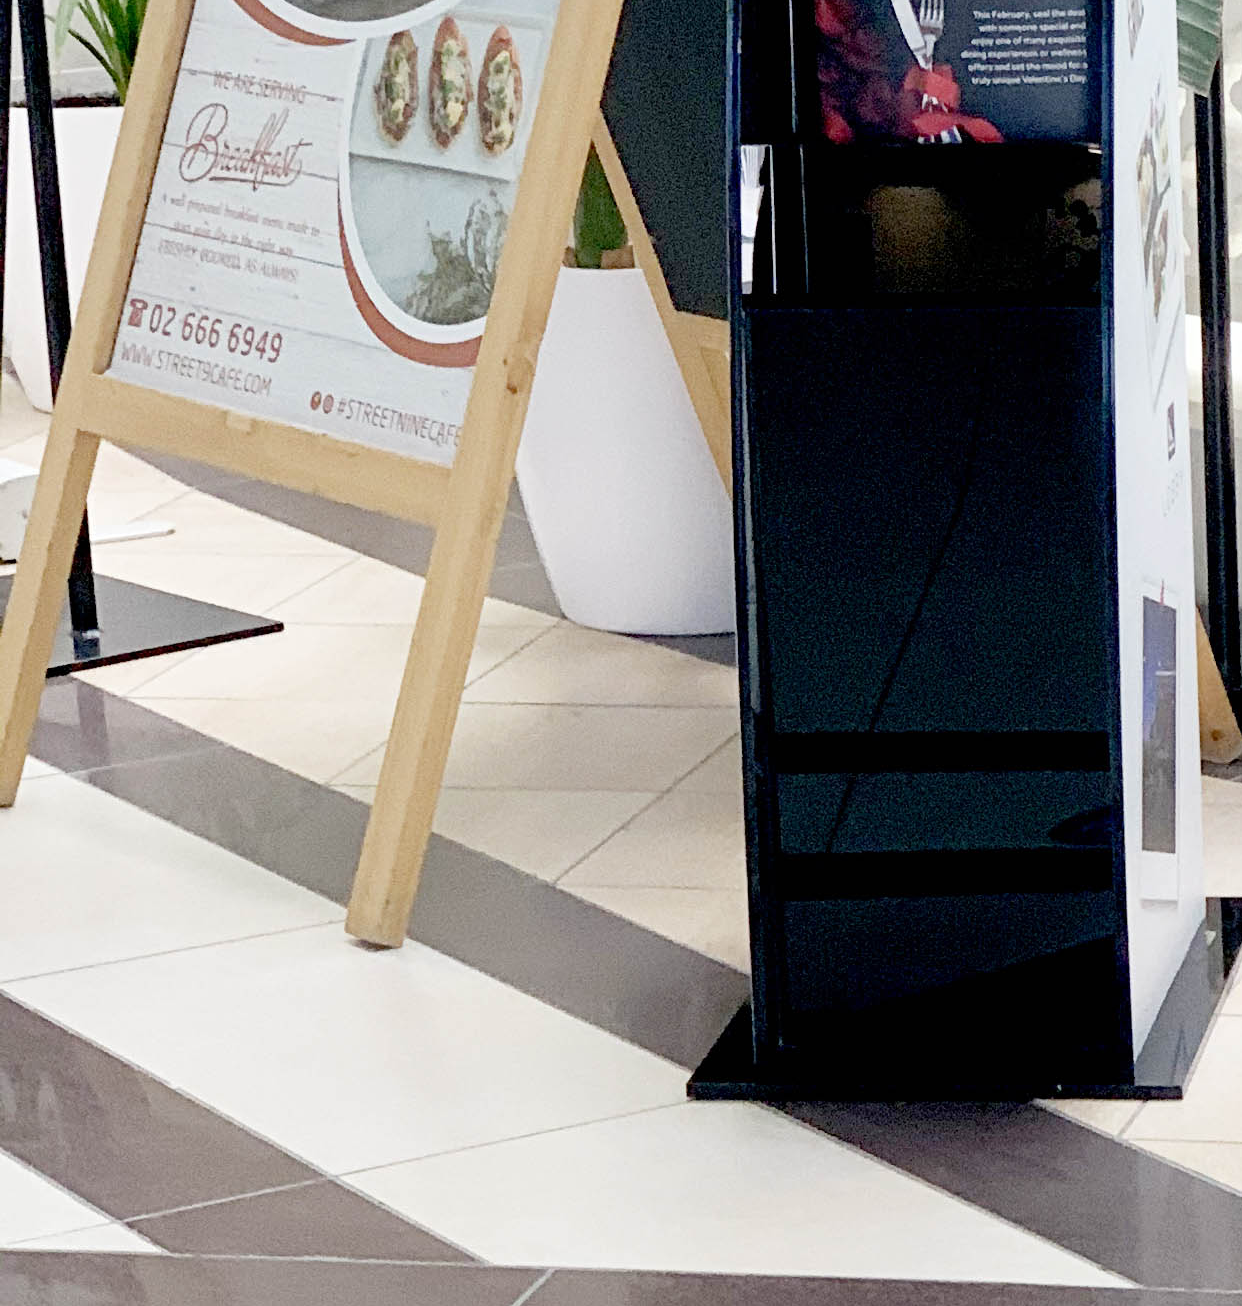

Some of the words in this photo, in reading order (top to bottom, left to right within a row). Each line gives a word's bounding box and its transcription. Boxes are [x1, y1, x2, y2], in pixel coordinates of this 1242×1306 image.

[149, 304, 176, 336] 02
[181, 312, 223, 348] 666
[227, 323, 283, 364] 6949
